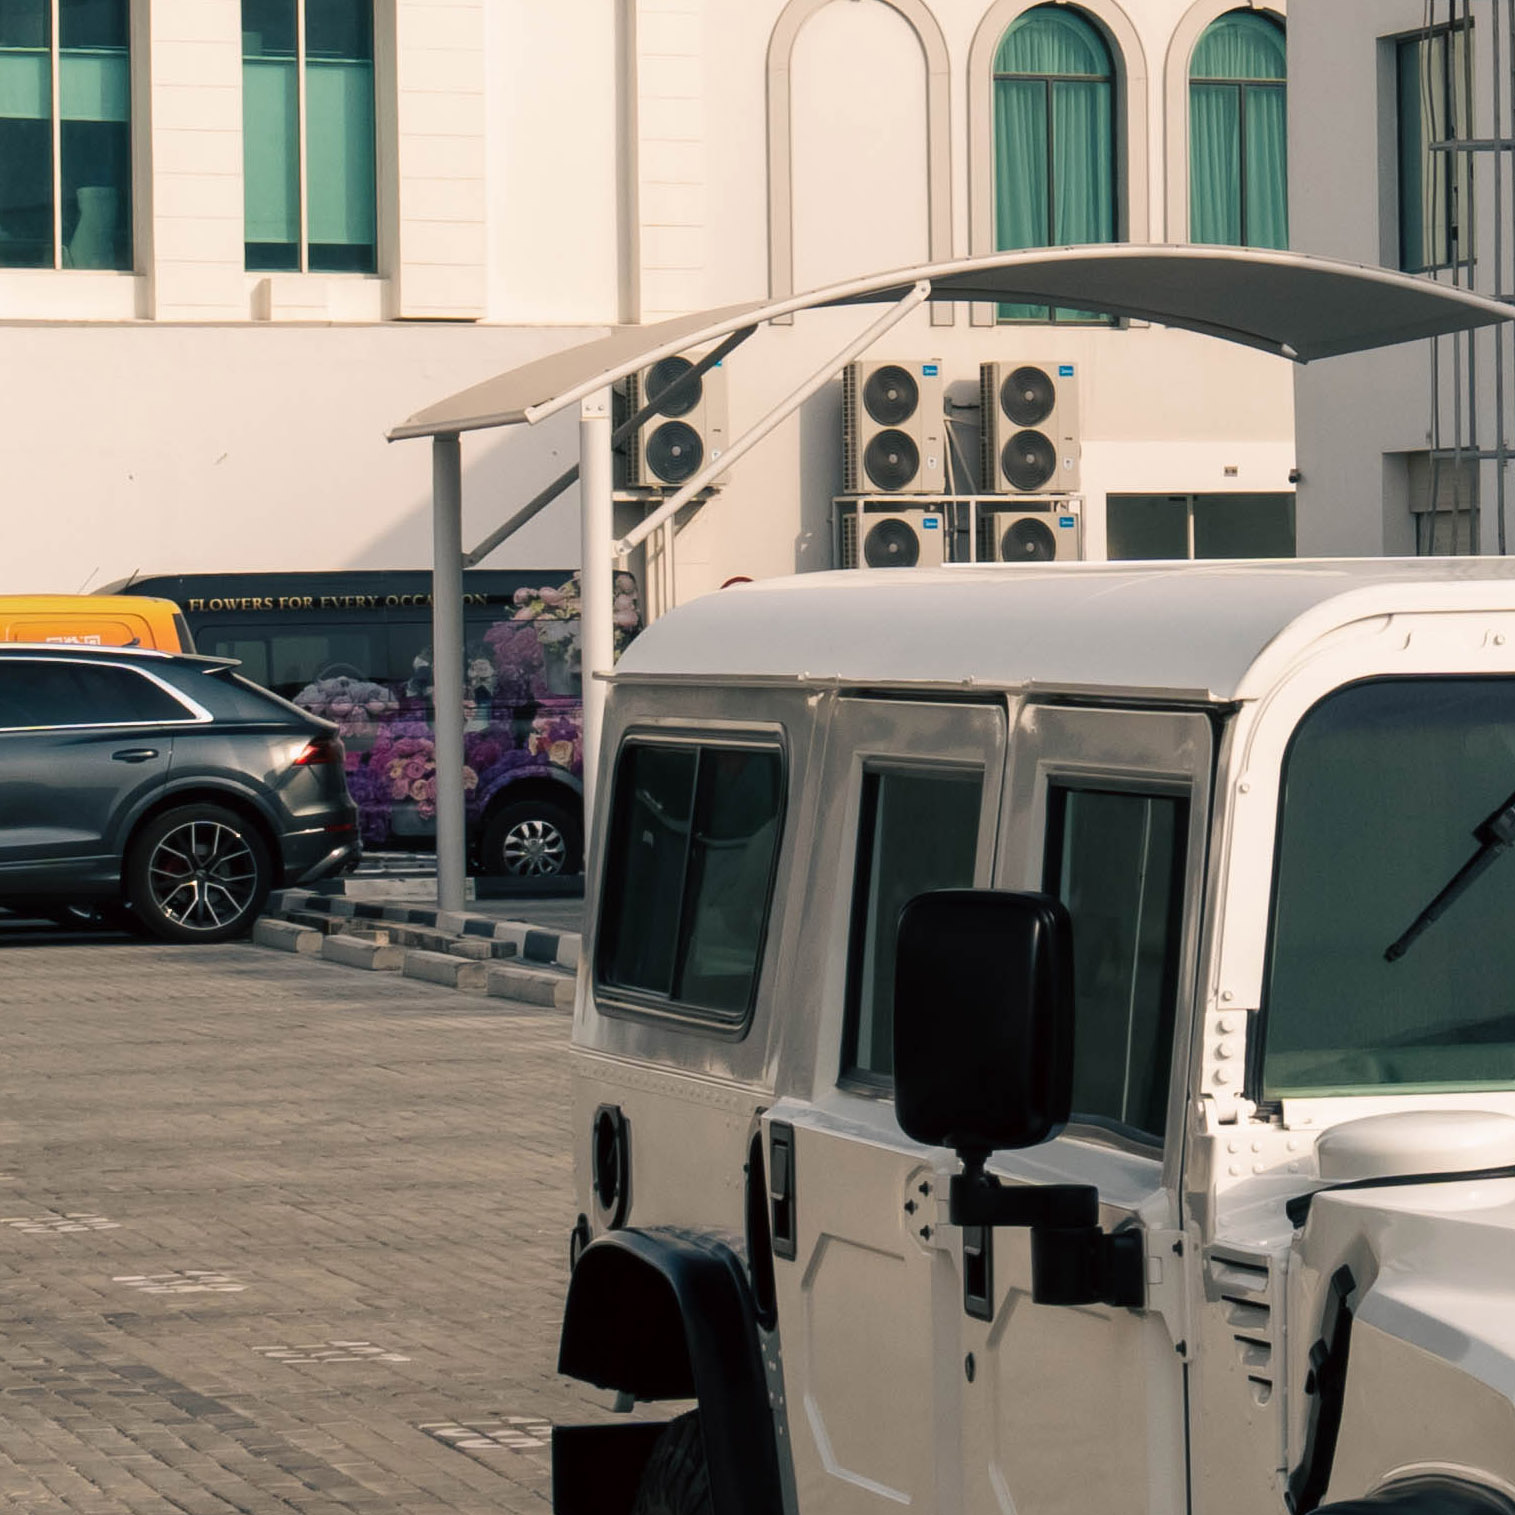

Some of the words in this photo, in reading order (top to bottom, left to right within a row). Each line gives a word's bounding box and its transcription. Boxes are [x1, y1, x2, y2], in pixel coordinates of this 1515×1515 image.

[189, 597, 273, 612] FLOWERS
[279, 596, 313, 609] FOR
[320, 595, 380, 609] EVERY
[385, 593, 488, 607] OCCAON
